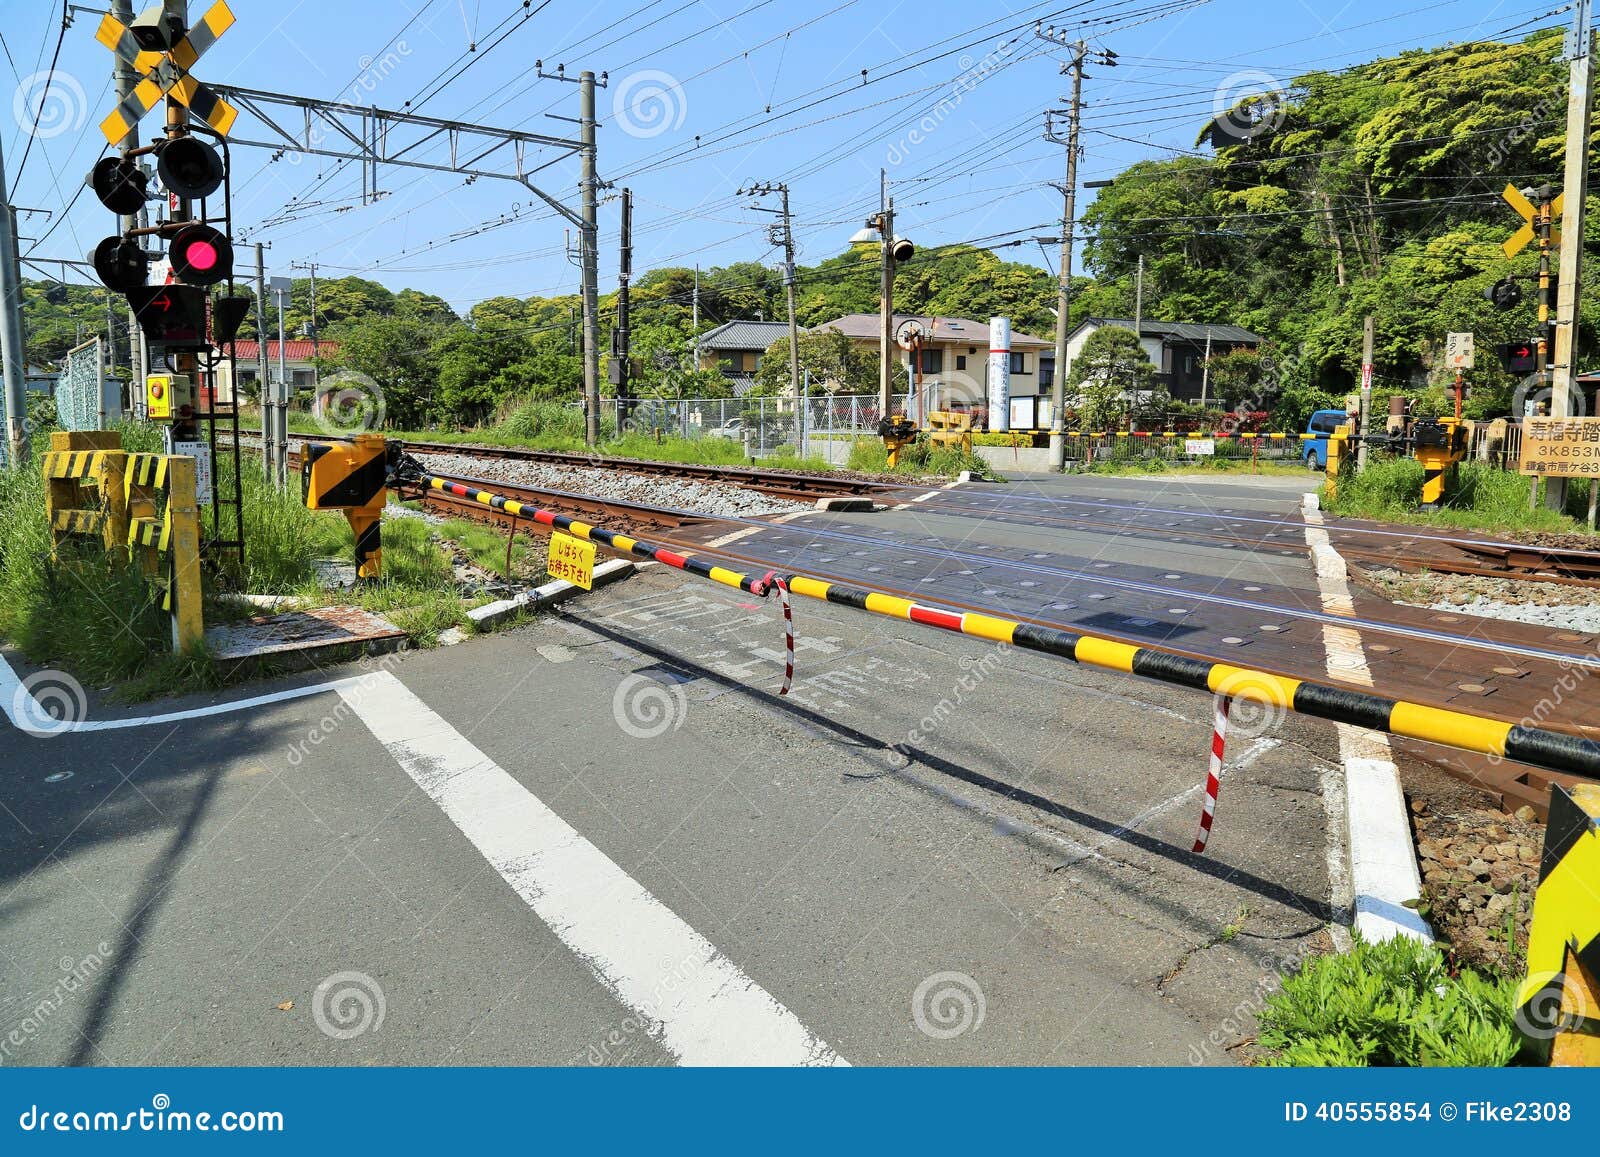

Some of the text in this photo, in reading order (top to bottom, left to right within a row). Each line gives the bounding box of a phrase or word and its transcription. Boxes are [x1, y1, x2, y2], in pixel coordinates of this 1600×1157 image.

[558, 542, 583, 563] しばらく
[549, 558, 591, 584] お待ち下さい
